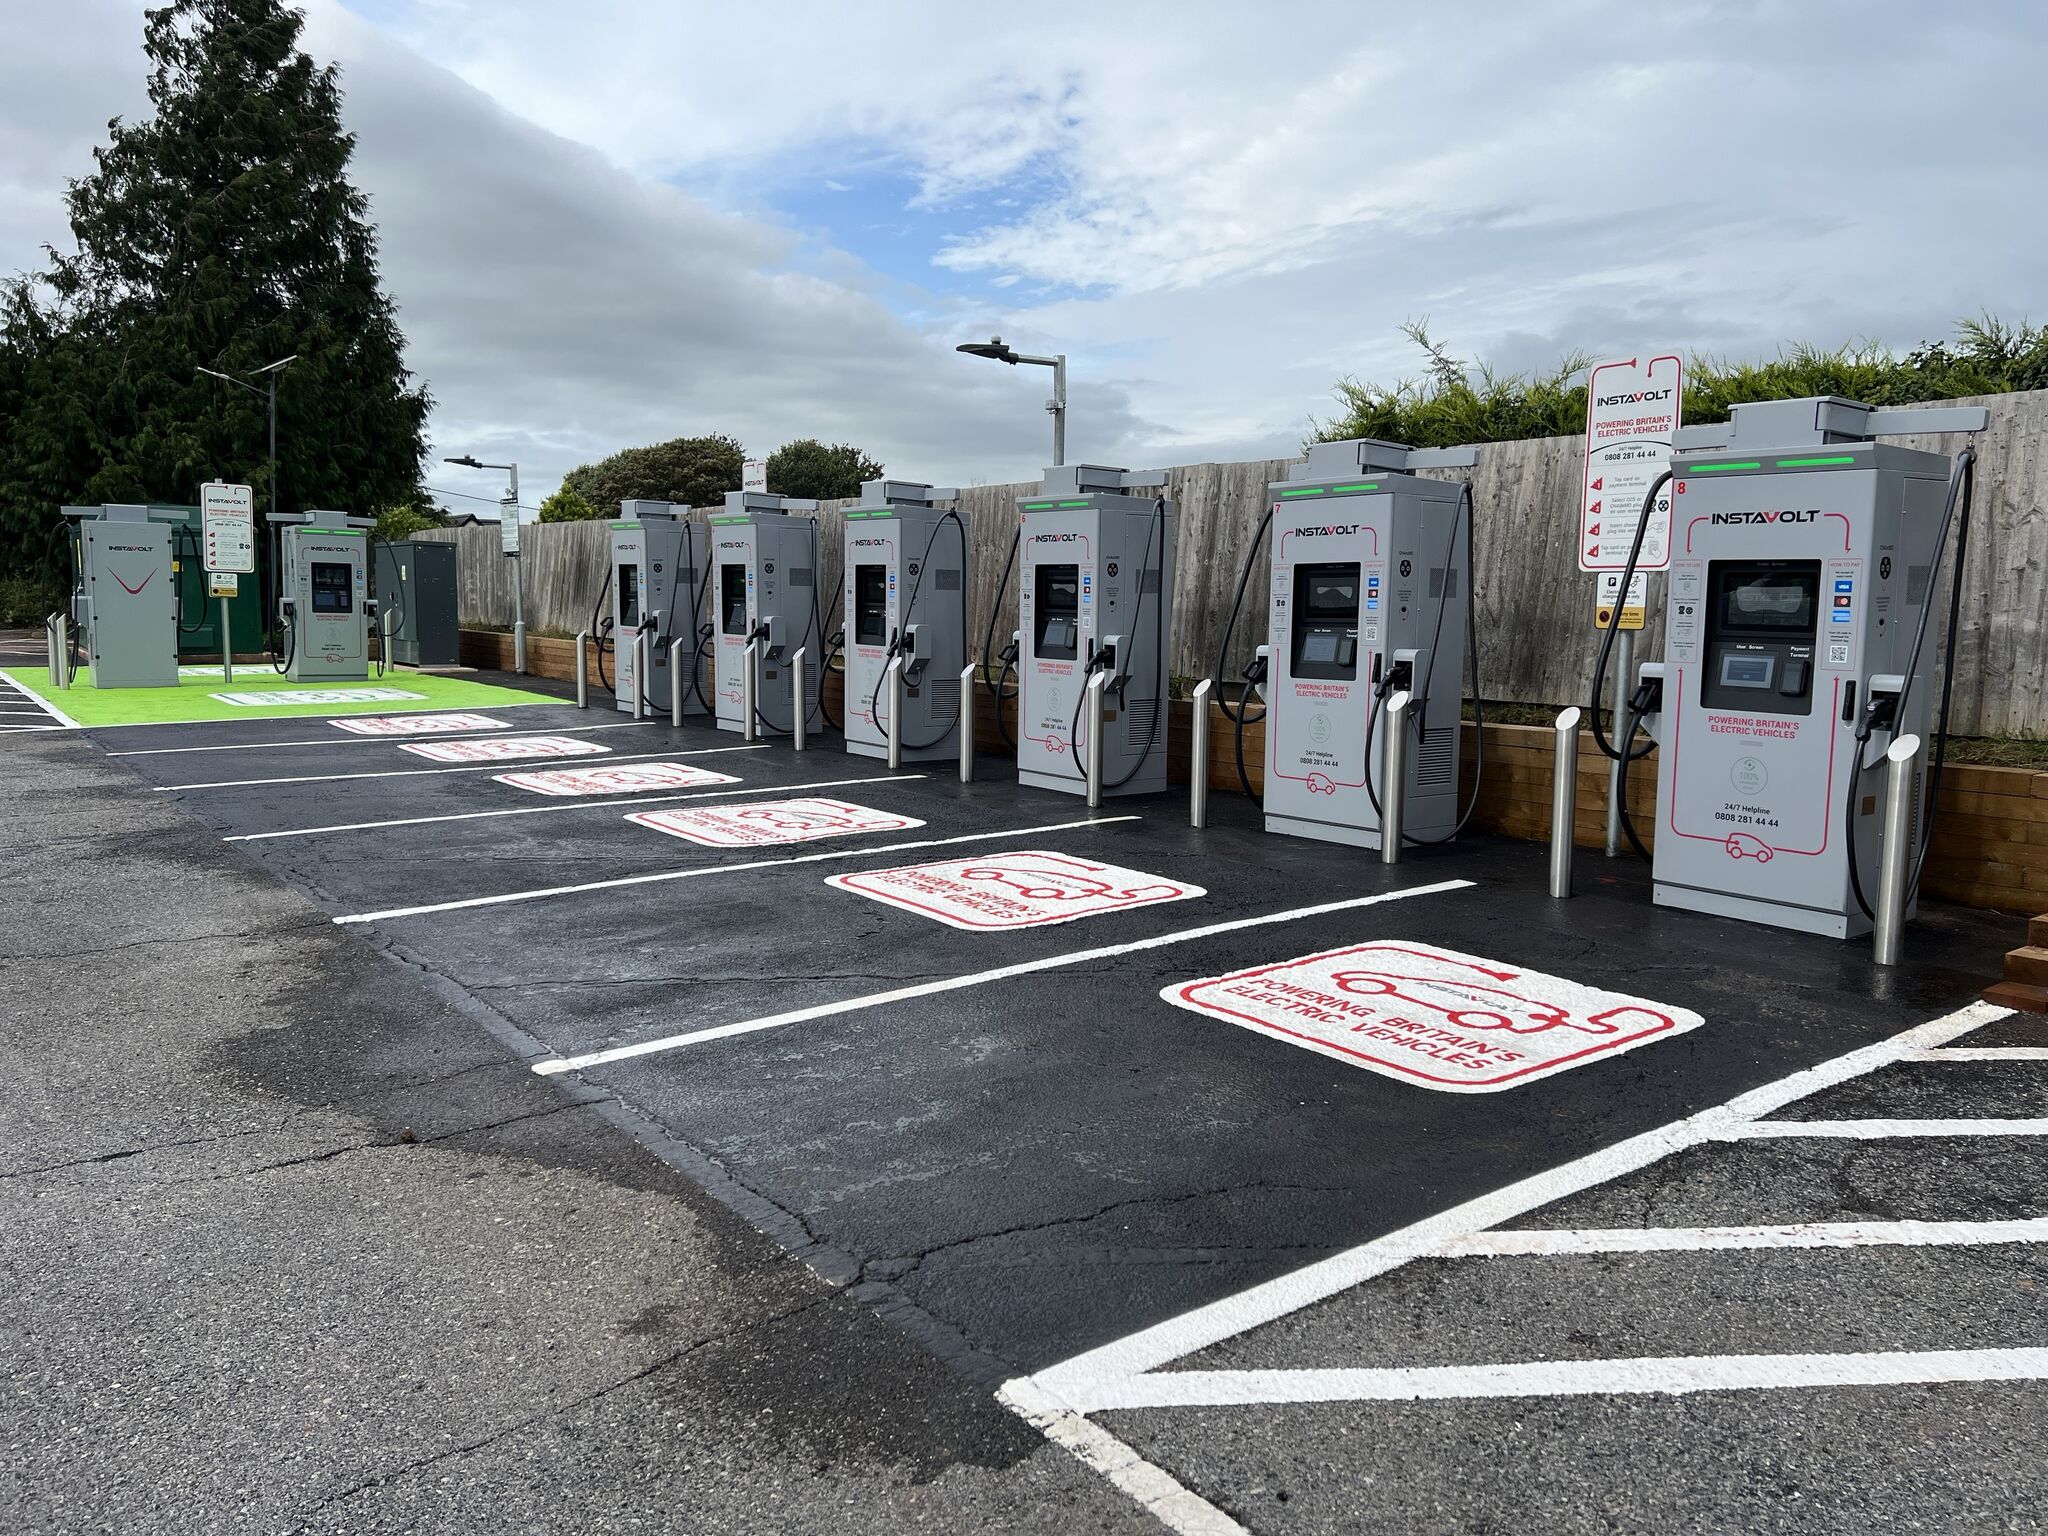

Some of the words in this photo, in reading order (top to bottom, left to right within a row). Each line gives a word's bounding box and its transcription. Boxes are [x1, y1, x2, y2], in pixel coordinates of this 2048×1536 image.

[1597, 389, 1672, 407] INSTAVOLT
[1596, 420, 1634, 430] POWERING
[1636, 415, 1672, 425] BRITAIN'S
[1597, 428, 1632, 438] ELECTRIC
[1633, 424, 1669, 434] VEHICLES
[1604, 453, 1621, 461] 0808
[1622, 452, 1634, 460] 281
[1647, 450, 1656, 458] 44
[1677, 482, 1686, 494] 8
[1275, 504, 1281, 514] 7
[1021, 514, 1026, 523] 6
[1712, 509, 1821, 525] INSTAVOLT
[1295, 524, 1360, 537] INSTAVOLT
[855, 538, 885, 546] INSTAVOLT
[1035, 533, 1078, 543] INSTAVOLT
[1295, 683, 1323, 691] POWERING
[1323, 685, 1350, 693] BRITAIN'S
[1296, 690, 1320, 698] ELECTRIC
[1708, 715, 1754, 727] POWERING
[1756, 719, 1800, 730] BRITAIN'S
[1711, 724, 1750, 735] ELECTRIC
[1752, 728, 1796, 739] VEHICLES
[1724, 803, 1740, 811] 24/7
[1741, 804, 1771, 815] Helpline
[1714, 812, 1736, 822] 0808
[1737, 815, 1752, 824] 281
[1755, 816, 1766, 826] 44
[1767, 818, 1779, 828] 44
[1415, 981, 1526, 1014] INSTAVOLT
[1221, 984, 1347, 1025] ELECTRIC
[1350, 1022, 1494, 1070] VEHICLES
[1247, 978, 1377, 1018] POWERING
[1380, 1016, 1527, 1063] BRITAIN'S
